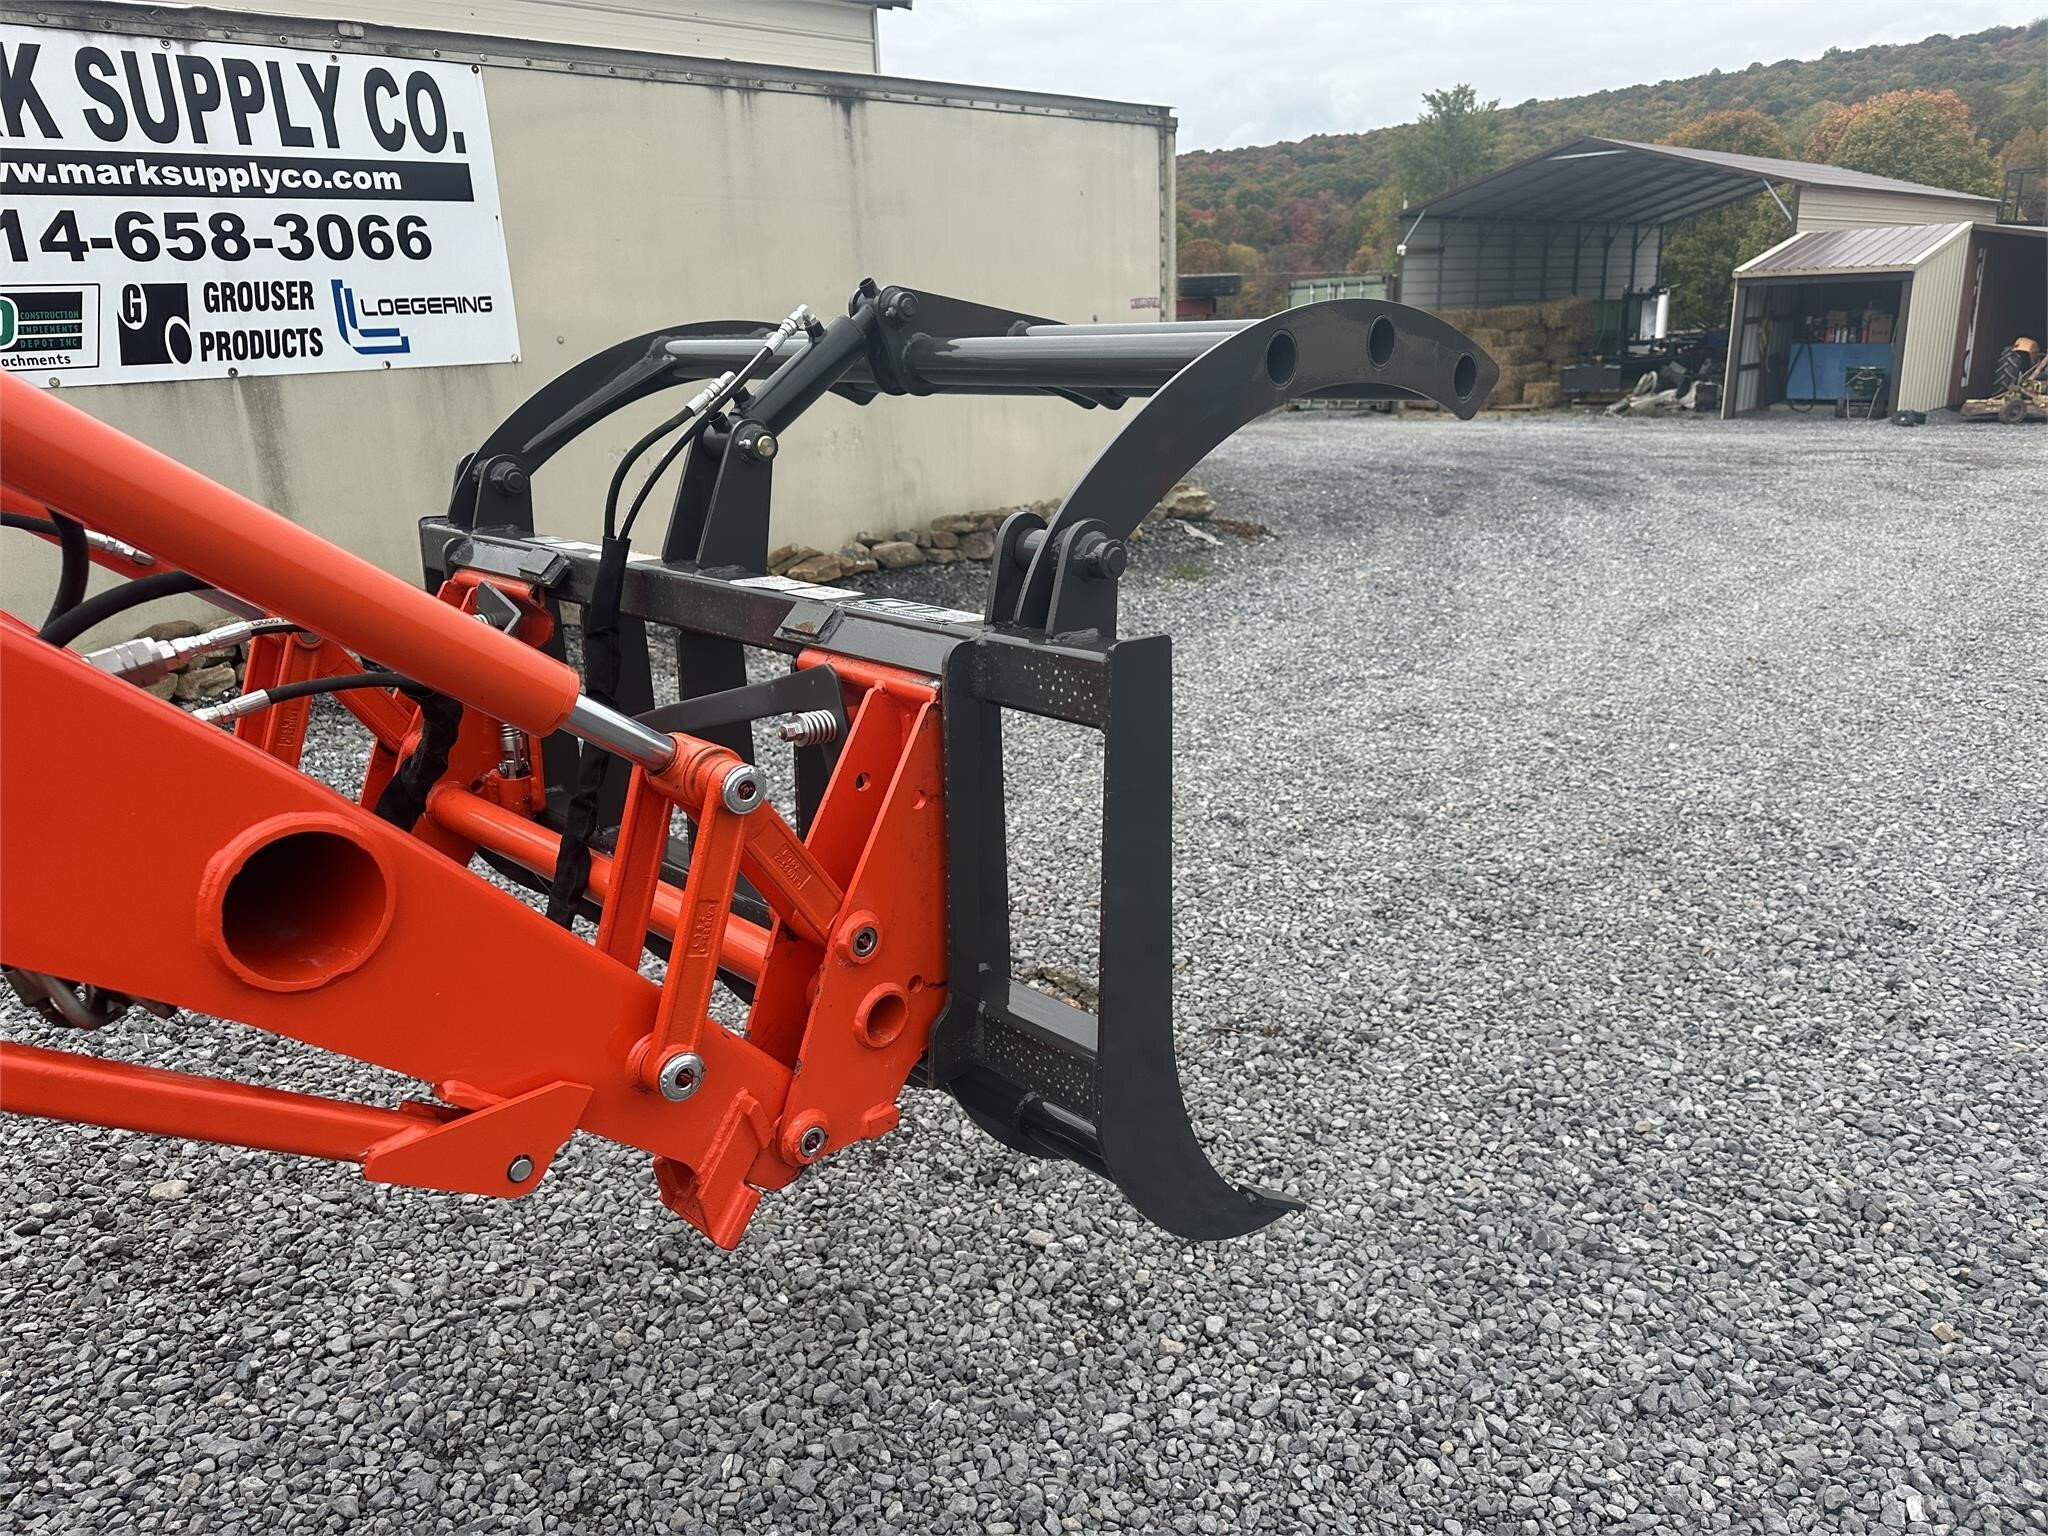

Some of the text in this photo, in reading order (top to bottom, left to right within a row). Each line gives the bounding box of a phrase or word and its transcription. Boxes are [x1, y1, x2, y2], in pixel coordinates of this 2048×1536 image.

[74, 46, 340, 149] SUPPLY
[364, 67, 466, 154] CO.
[203, 281, 315, 313] GROUSER
[360, 296, 493, 316] LOEGERING
[20, 310, 79, 320] CONSTRUCTION
[20, 324, 79, 334] IMPLEMENTS
[20, 338, 78, 348] DEPOT INC
[200, 327, 324, 362] PRODUCTS
[0, 354, 71, 367] achments
